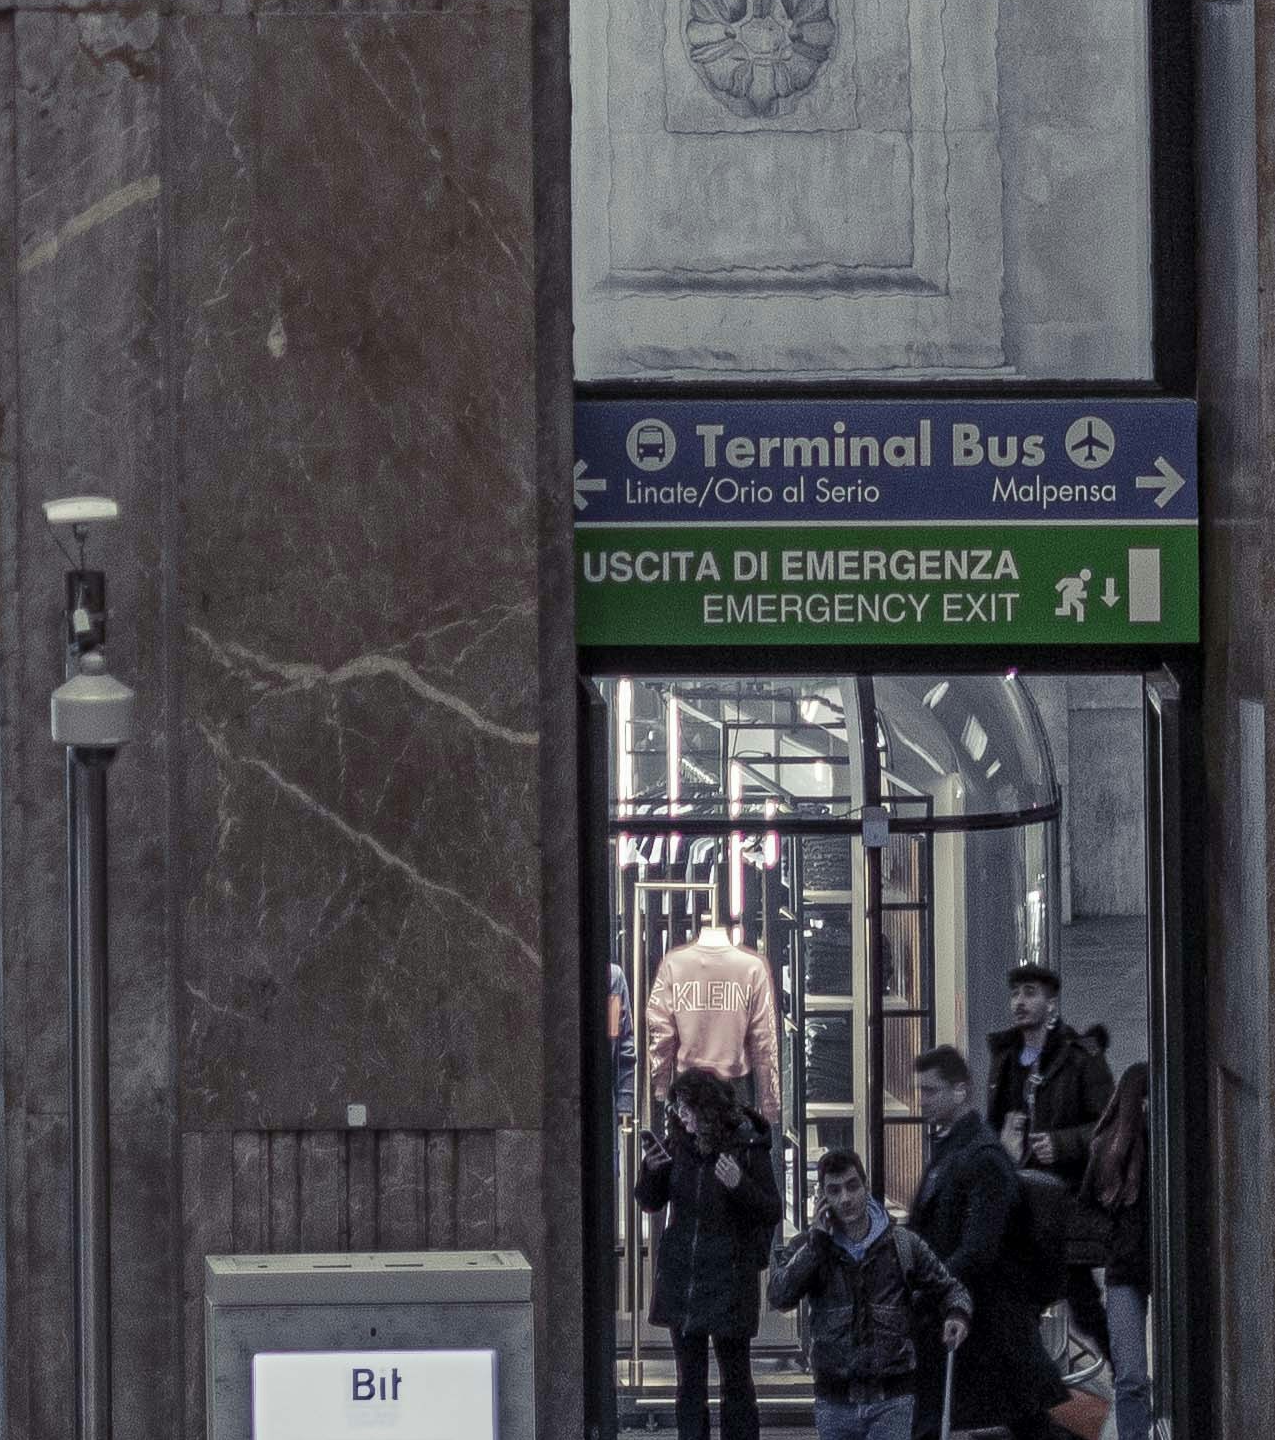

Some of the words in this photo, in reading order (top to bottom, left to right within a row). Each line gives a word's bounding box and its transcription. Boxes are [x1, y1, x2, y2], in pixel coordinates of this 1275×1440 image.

[695, 419, 932, 469] Terminal
[952, 422, 1046, 468] Bus
[625, 476, 773, 506] Linate/Orio
[782, 476, 805, 504] al
[815, 475, 880, 504] Serio
[991, 475, 1117, 510] Malpensa
[582, 550, 721, 583] USCITA
[733, 550, 769, 581] DI
[781, 548, 1019, 582] EMERGENZA
[703, 594, 930, 624] EMERGENCY
[942, 592, 1020, 623] EXIT
[673, 981, 752, 1012] KLEIN
[352, 1368, 402, 1402] Bit
